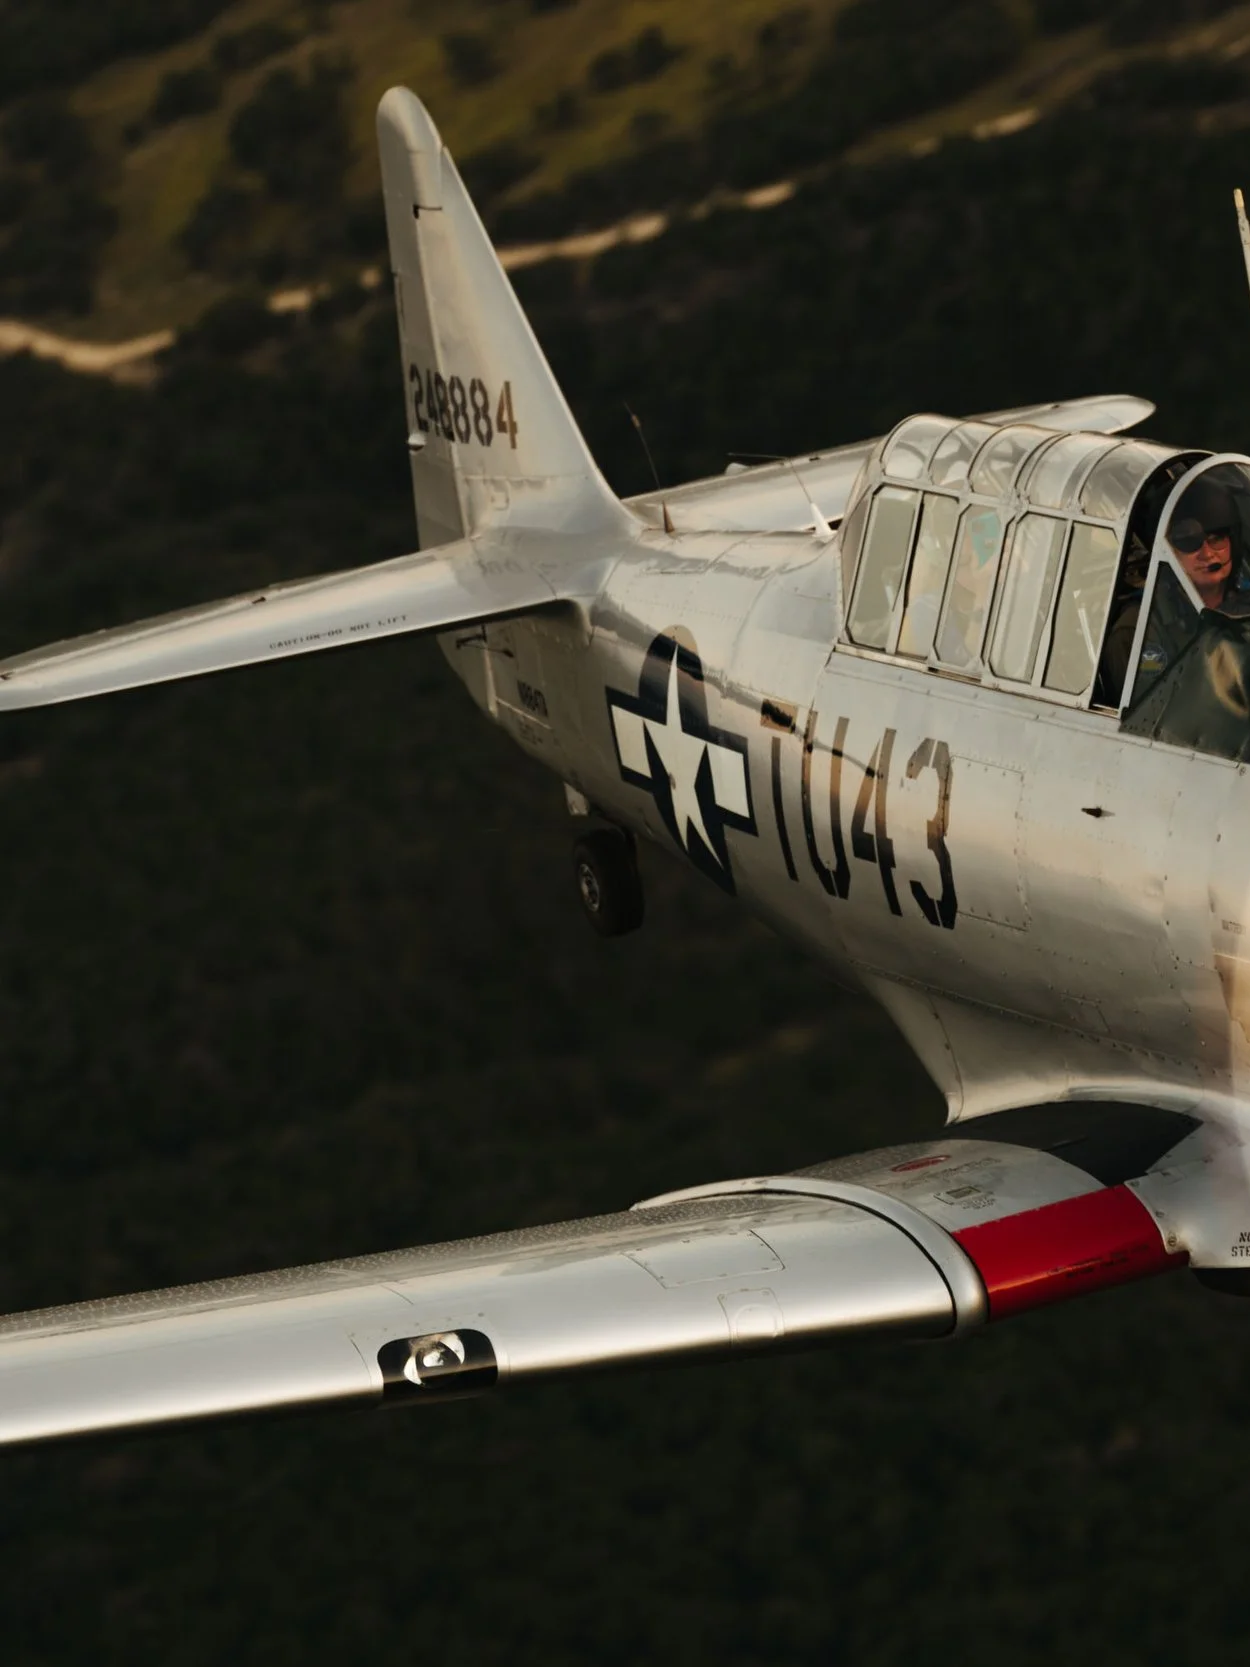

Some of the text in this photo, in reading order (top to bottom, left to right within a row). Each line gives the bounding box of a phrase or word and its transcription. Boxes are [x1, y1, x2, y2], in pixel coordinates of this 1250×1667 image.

[409, 362, 518, 450] 248884
[349, 621, 371, 633] NOT
[378, 614, 408, 627] LIFT
